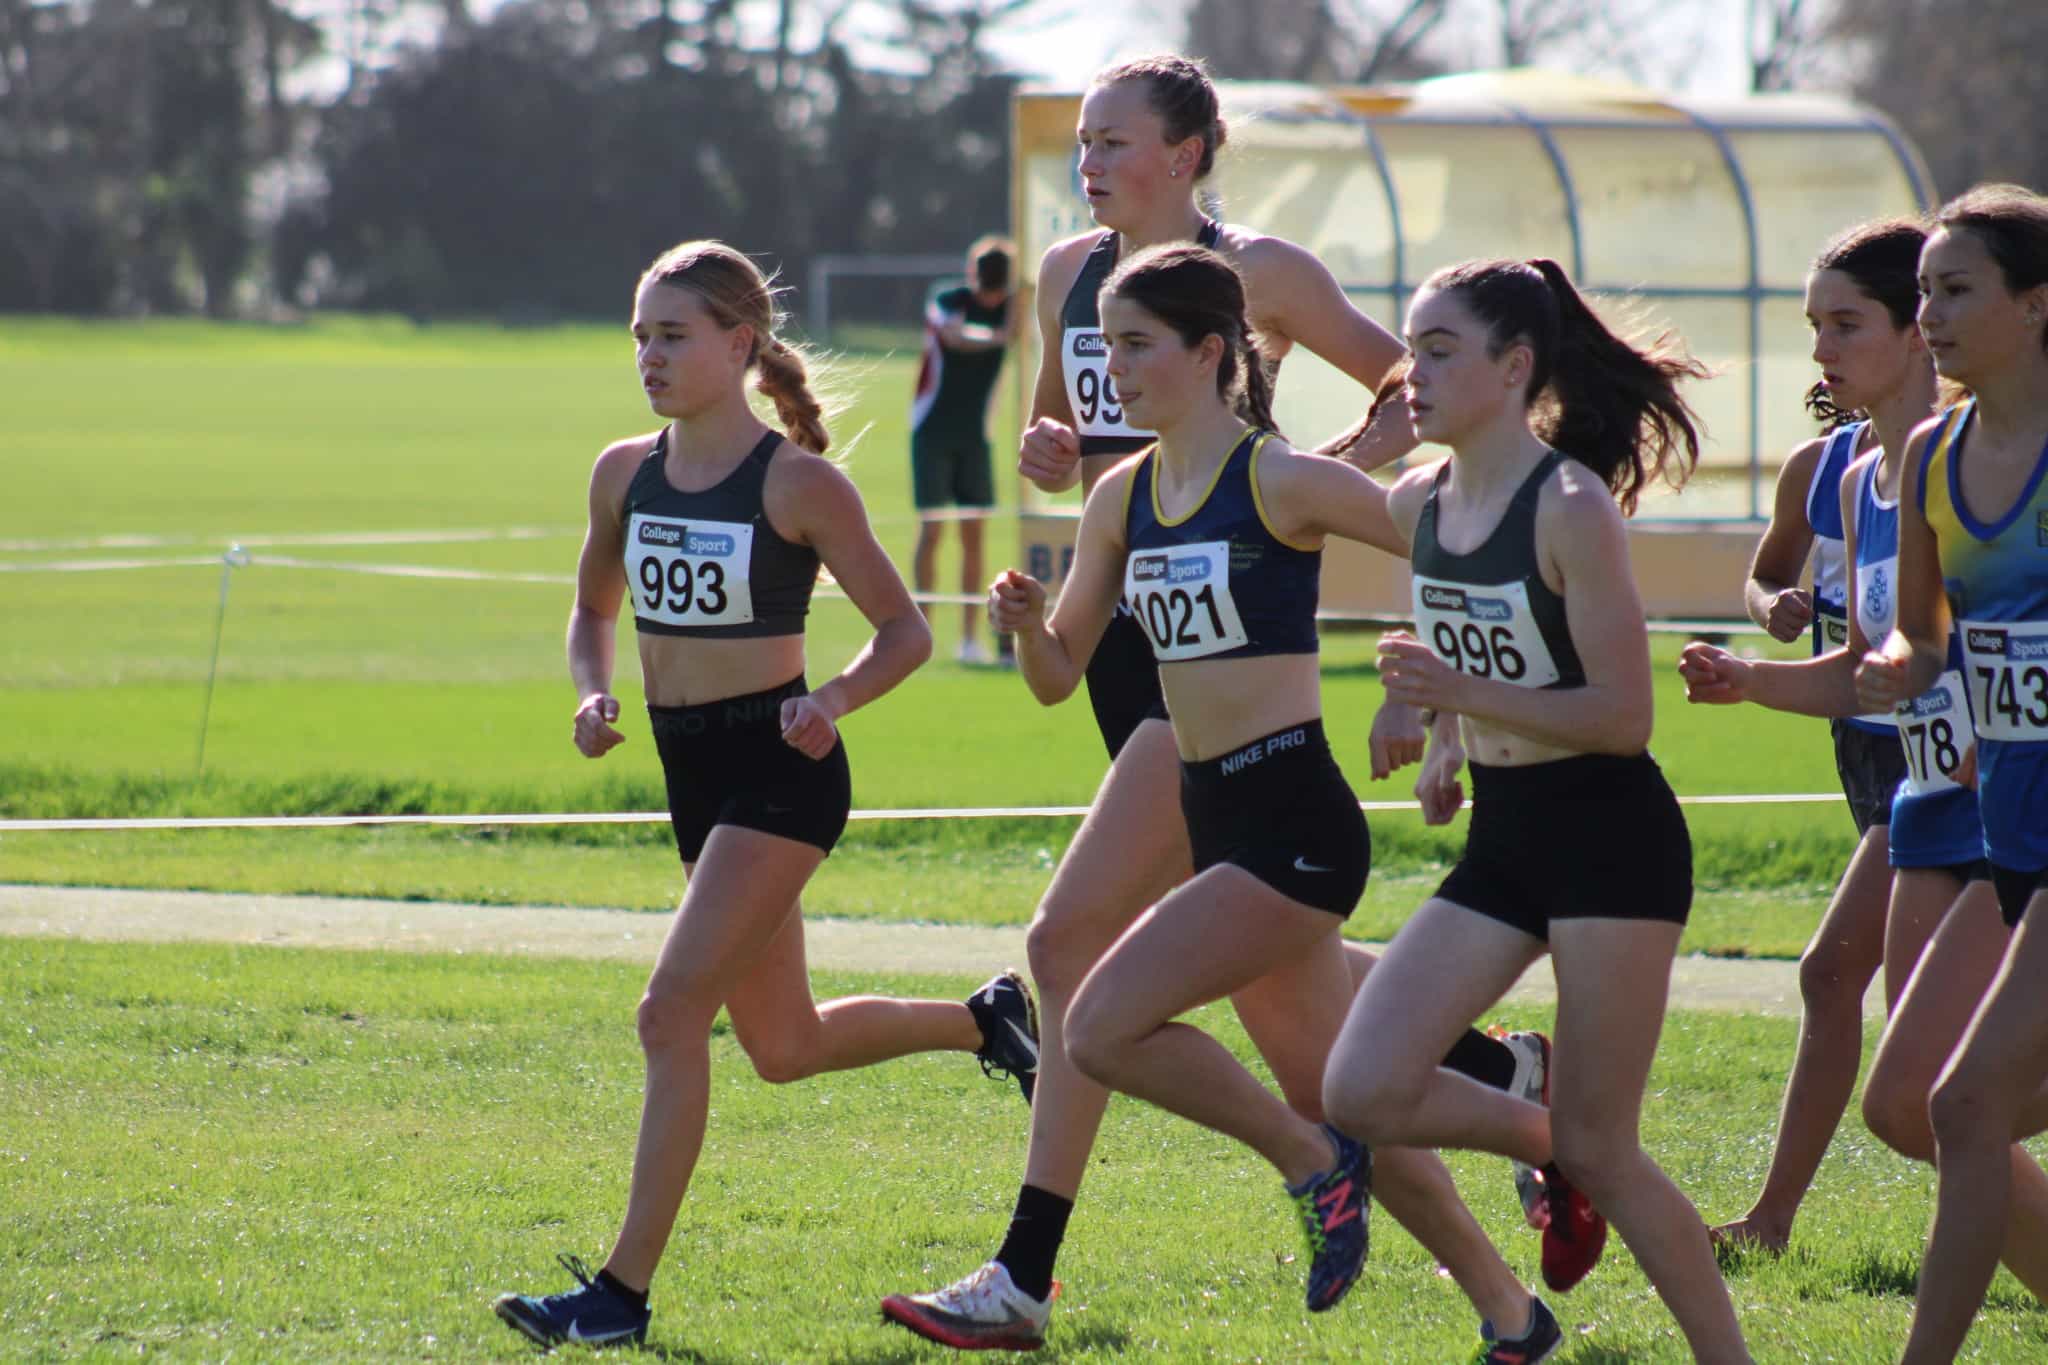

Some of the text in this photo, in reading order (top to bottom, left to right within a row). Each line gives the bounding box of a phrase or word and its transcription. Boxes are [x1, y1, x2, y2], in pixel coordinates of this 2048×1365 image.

[1077, 368, 1124, 424] 99
[641, 525, 729, 554] College Sport
[639, 555, 728, 616] 993
[1168, 561, 1206, 582] Sport
[1133, 583, 1226, 649] 1021
[1424, 588, 1507, 619] College Sport
[1433, 621, 1526, 681] 996
[1916, 692, 1947, 714] Sport
[1975, 666, 2048, 727] 743
[1220, 729, 1307, 777] NIKE PRO
